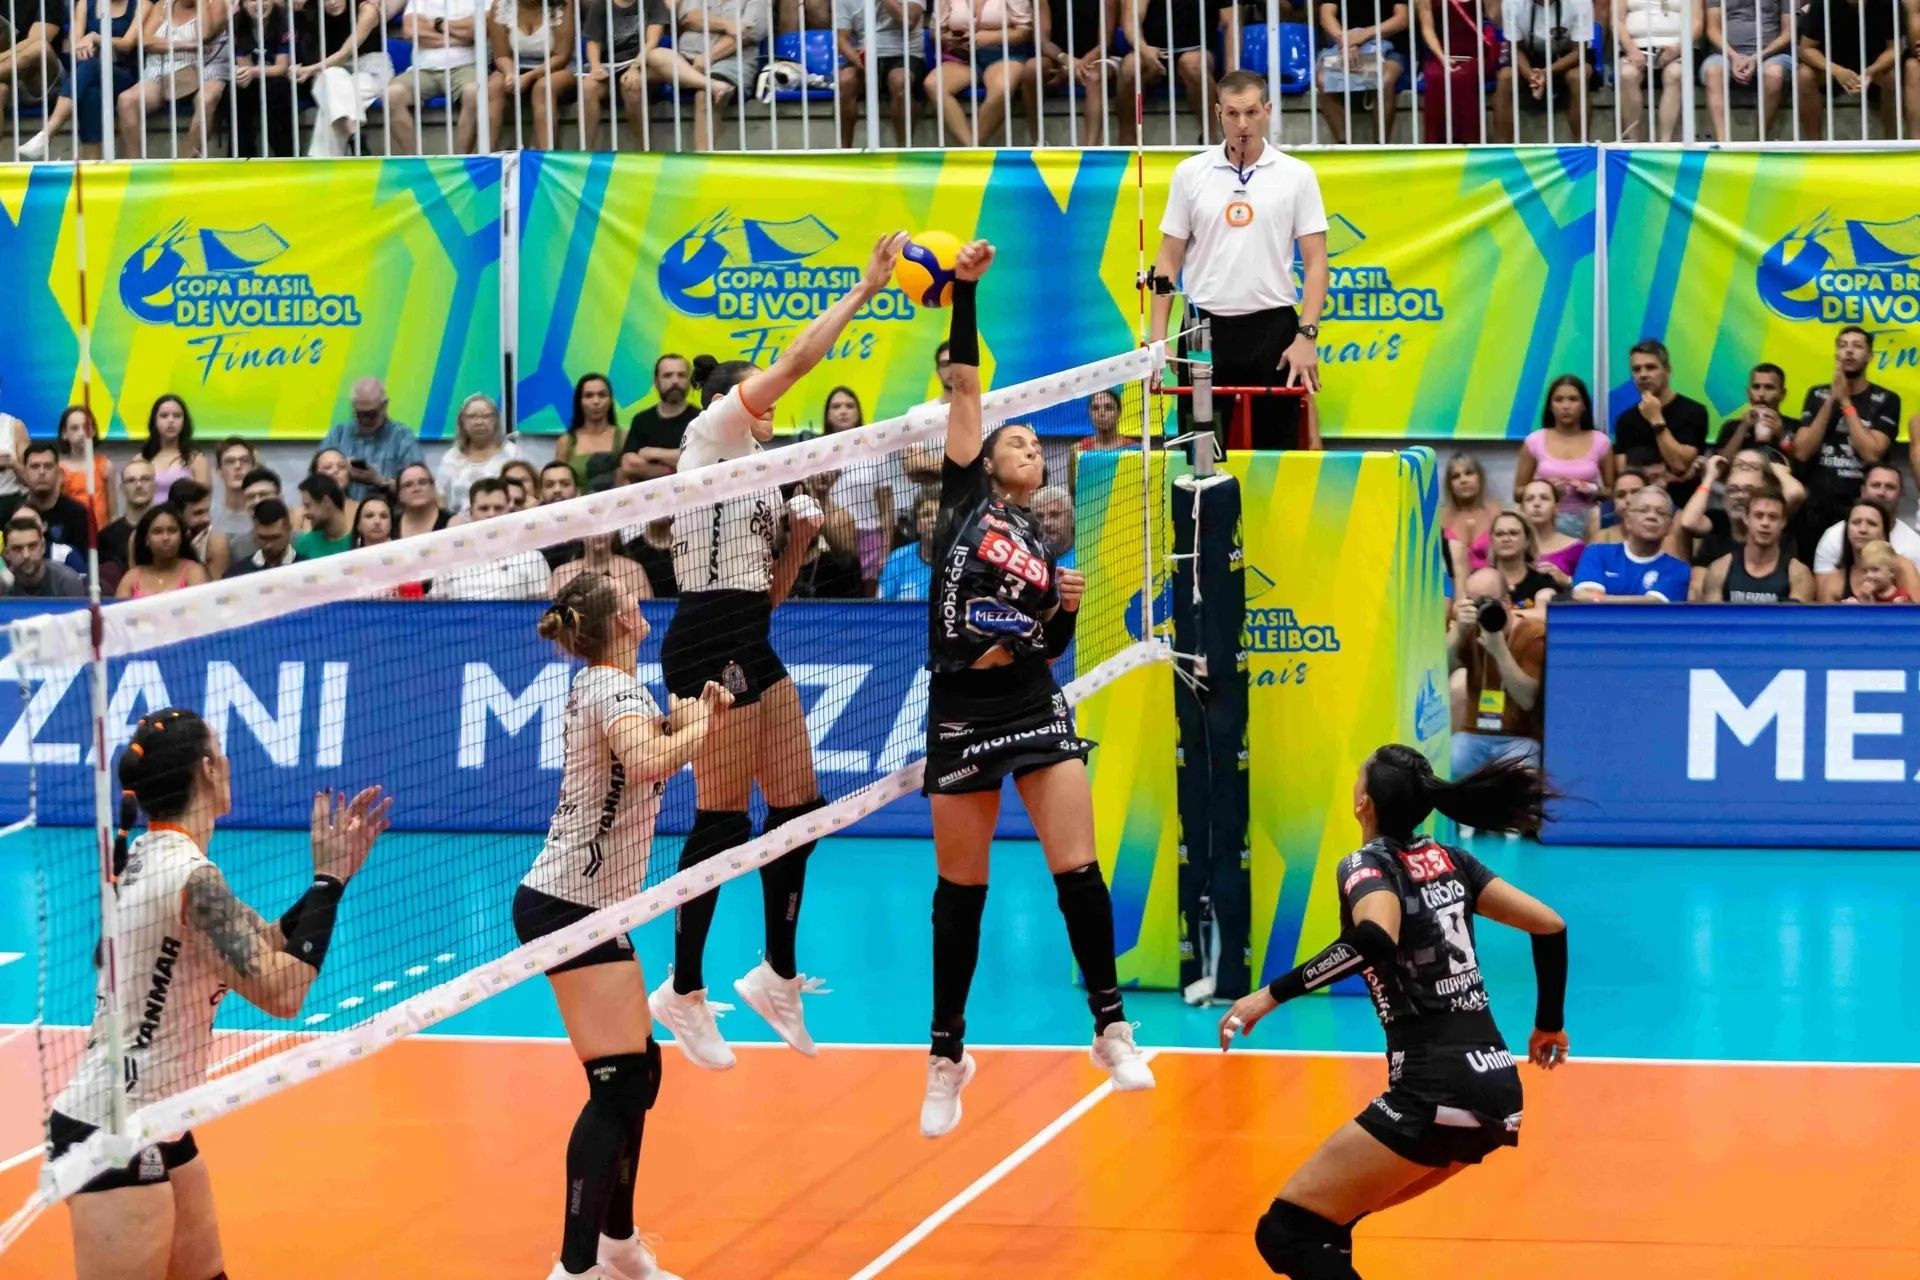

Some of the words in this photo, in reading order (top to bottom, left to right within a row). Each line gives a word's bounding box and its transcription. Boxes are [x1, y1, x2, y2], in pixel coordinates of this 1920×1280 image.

[175, 279, 232, 297] COPA
[238, 278, 310, 296] BRASIL
[718, 271, 778, 288] COPA
[784, 271, 856, 288] BRASIL
[1329, 271, 1387, 289] RASIL
[1820, 273, 1885, 292] COPA
[177, 300, 210, 323] DE
[220, 299, 358, 323] VOLEIBOL
[719, 293, 754, 315] DE
[1321, 292, 1440, 317] OLEIBOL
[1822, 295, 1860, 319] DE
[730, 325, 878, 365] Fiis
[1317, 329, 1403, 364] nais
[187, 331, 328, 386] Finais
[986, 539, 1047, 587] SESI
[999, 572, 1027, 600] 3
[1246, 611, 1294, 627] RASIL
[1687, 669, 1920, 781] ME
[130, 936, 181, 1052] YANMAR
